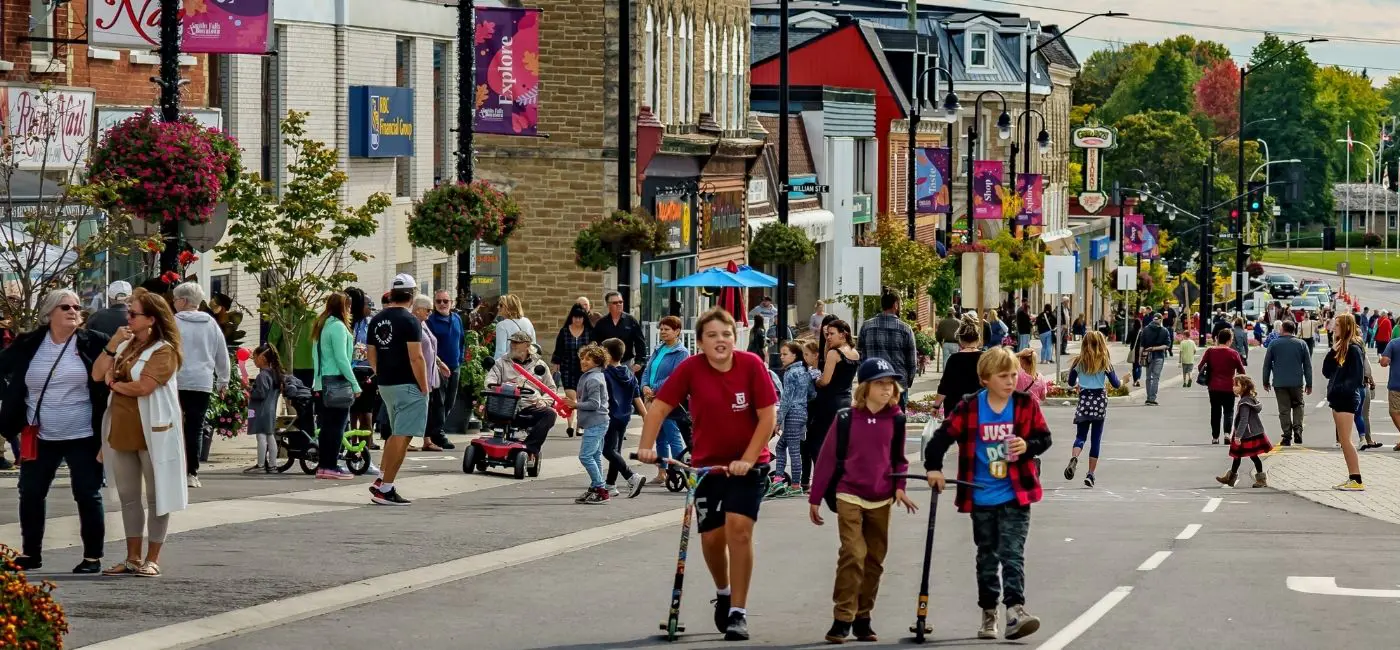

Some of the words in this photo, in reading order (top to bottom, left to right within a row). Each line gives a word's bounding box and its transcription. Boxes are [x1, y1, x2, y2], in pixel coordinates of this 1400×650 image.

[498, 36, 516, 105] Explore
[380, 96, 389, 114] RBC
[380, 117, 399, 135] Financial
[983, 179, 993, 201] Shop
[1026, 184, 1034, 214] Explore
[982, 424, 1014, 441] JUST
